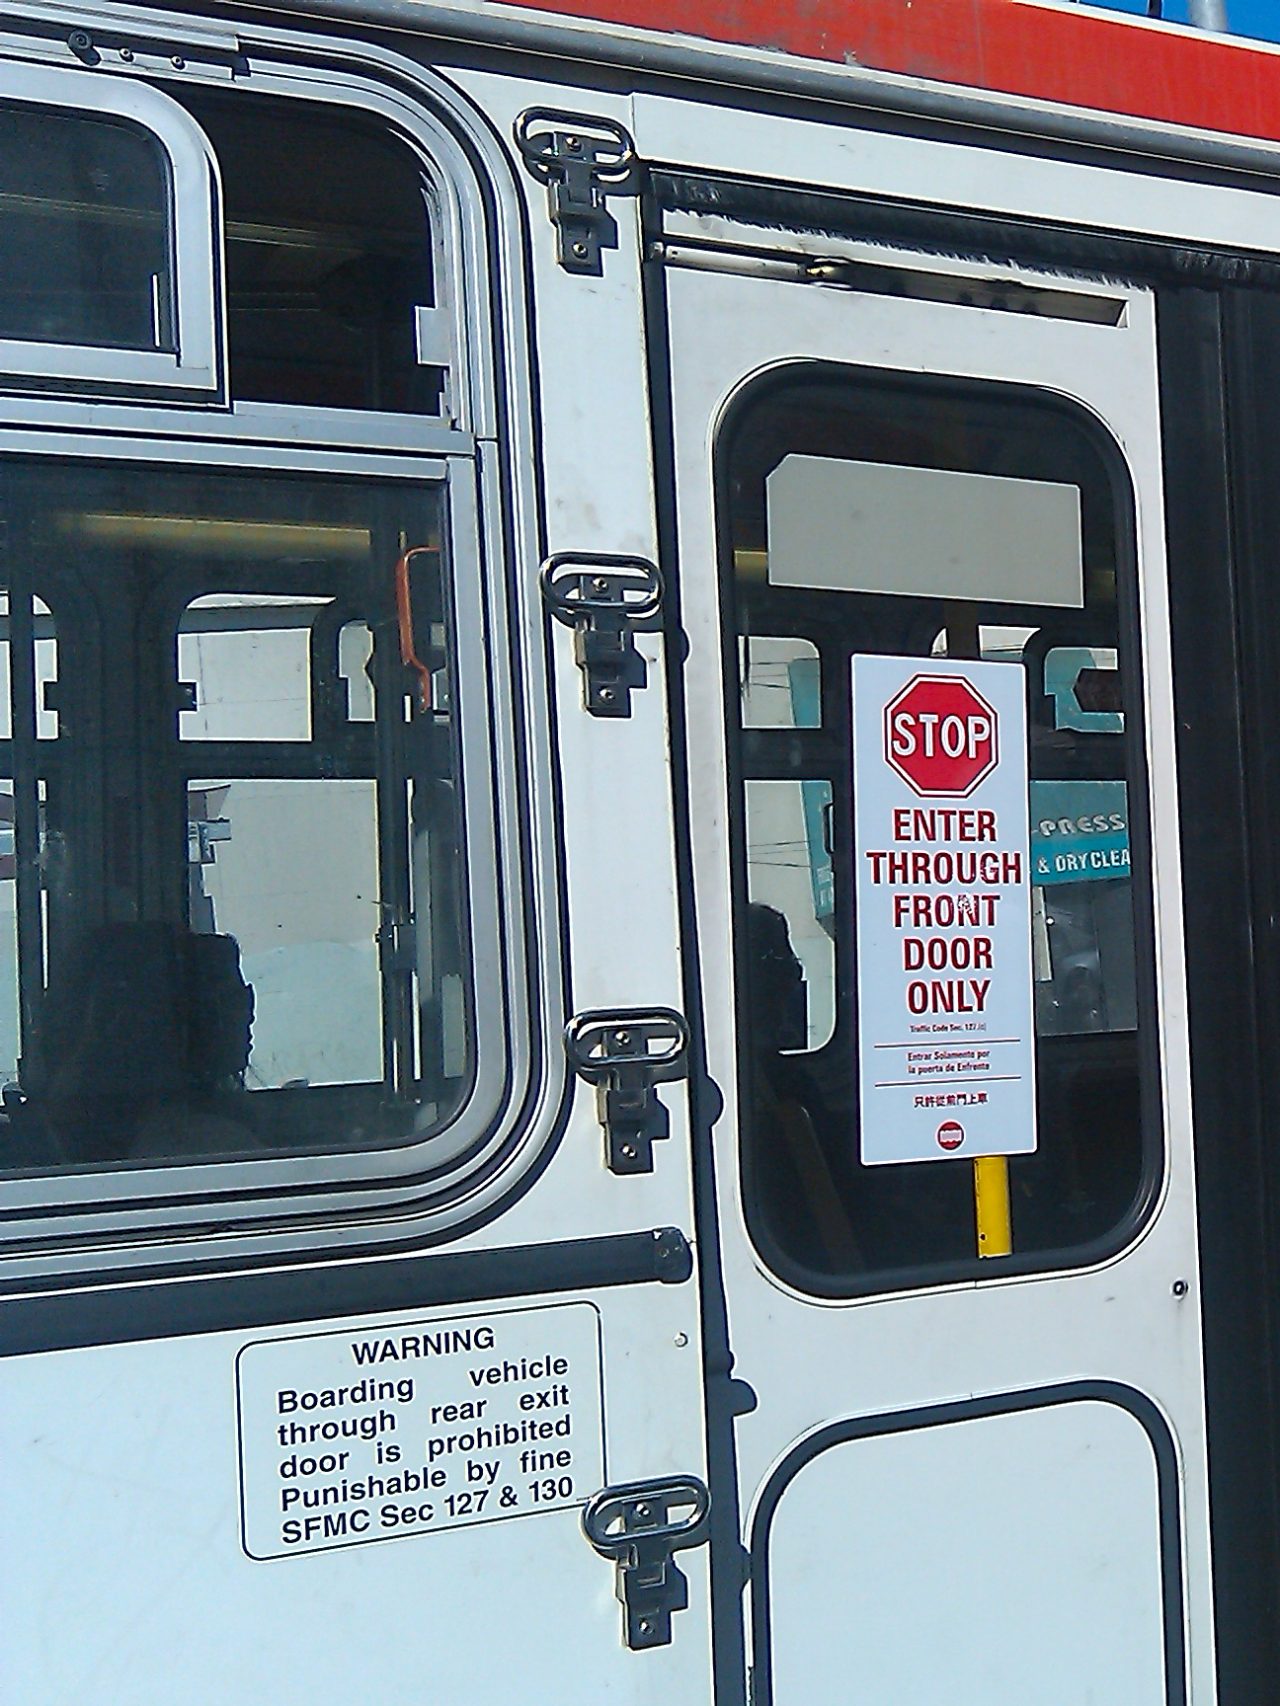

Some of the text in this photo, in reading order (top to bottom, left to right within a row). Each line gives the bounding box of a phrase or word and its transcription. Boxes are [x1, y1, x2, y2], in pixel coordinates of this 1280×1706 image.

[892, 713, 990, 758] STOP
[893, 809, 997, 842] ENTER
[866, 852, 1022, 884] THROUGH
[1038, 857, 1050, 874] &
[894, 895, 1000, 928] FRONT
[904, 937, 993, 971] DOOR
[908, 980, 991, 1014] ONLY
[910, 1025, 931, 1033] Traffic
[932, 1024, 948, 1032] Code
[908, 1050, 990, 1061] Entrar Solamente por
[945, 1063, 955, 1072] de
[351, 1327, 494, 1366] WARNING
[277, 1355, 568, 1414] Boarding vehicle
[277, 1385, 569, 1447] through rear exit
[279, 1415, 571, 1479] door is prohibited
[281, 1448, 571, 1511] Punishable by fine
[281, 1476, 574, 1544] SFMC Sec 127 & 130
